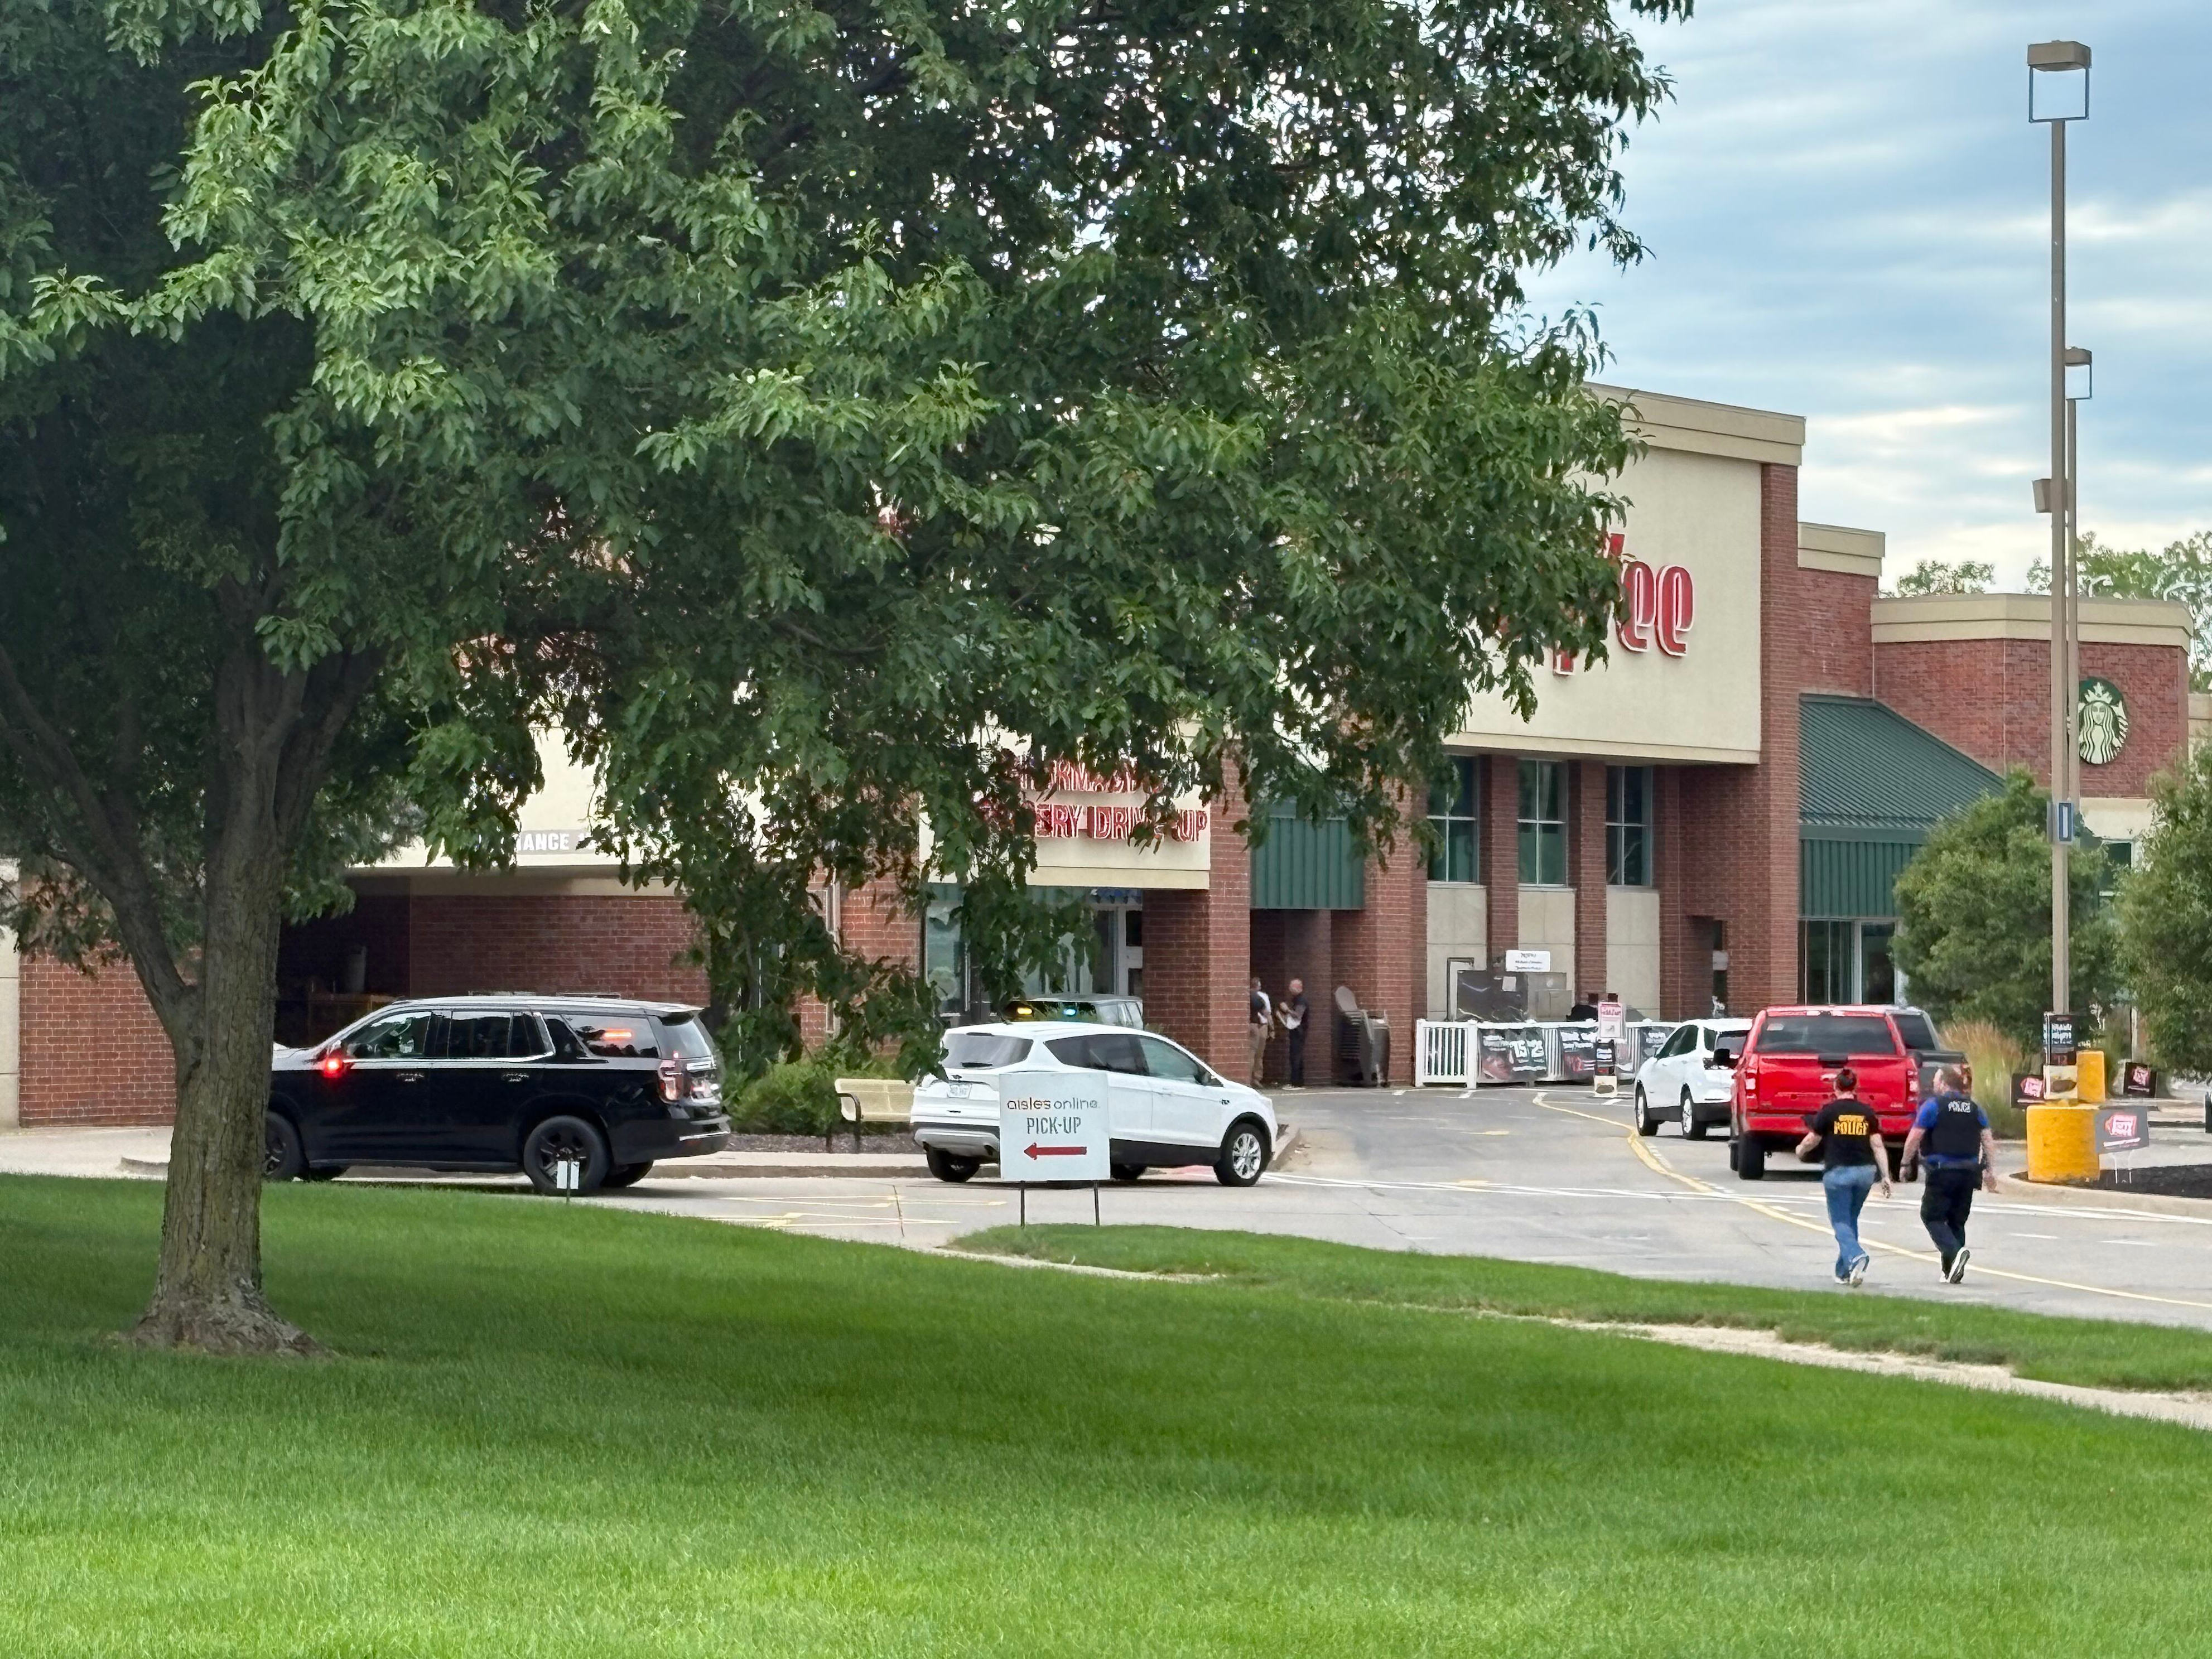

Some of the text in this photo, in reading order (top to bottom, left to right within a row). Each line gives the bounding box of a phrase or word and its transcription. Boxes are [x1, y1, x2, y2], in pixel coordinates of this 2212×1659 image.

[1006, 1097, 1098, 1110] aisles online
[1027, 1116, 1081, 1135] PICK-UP
